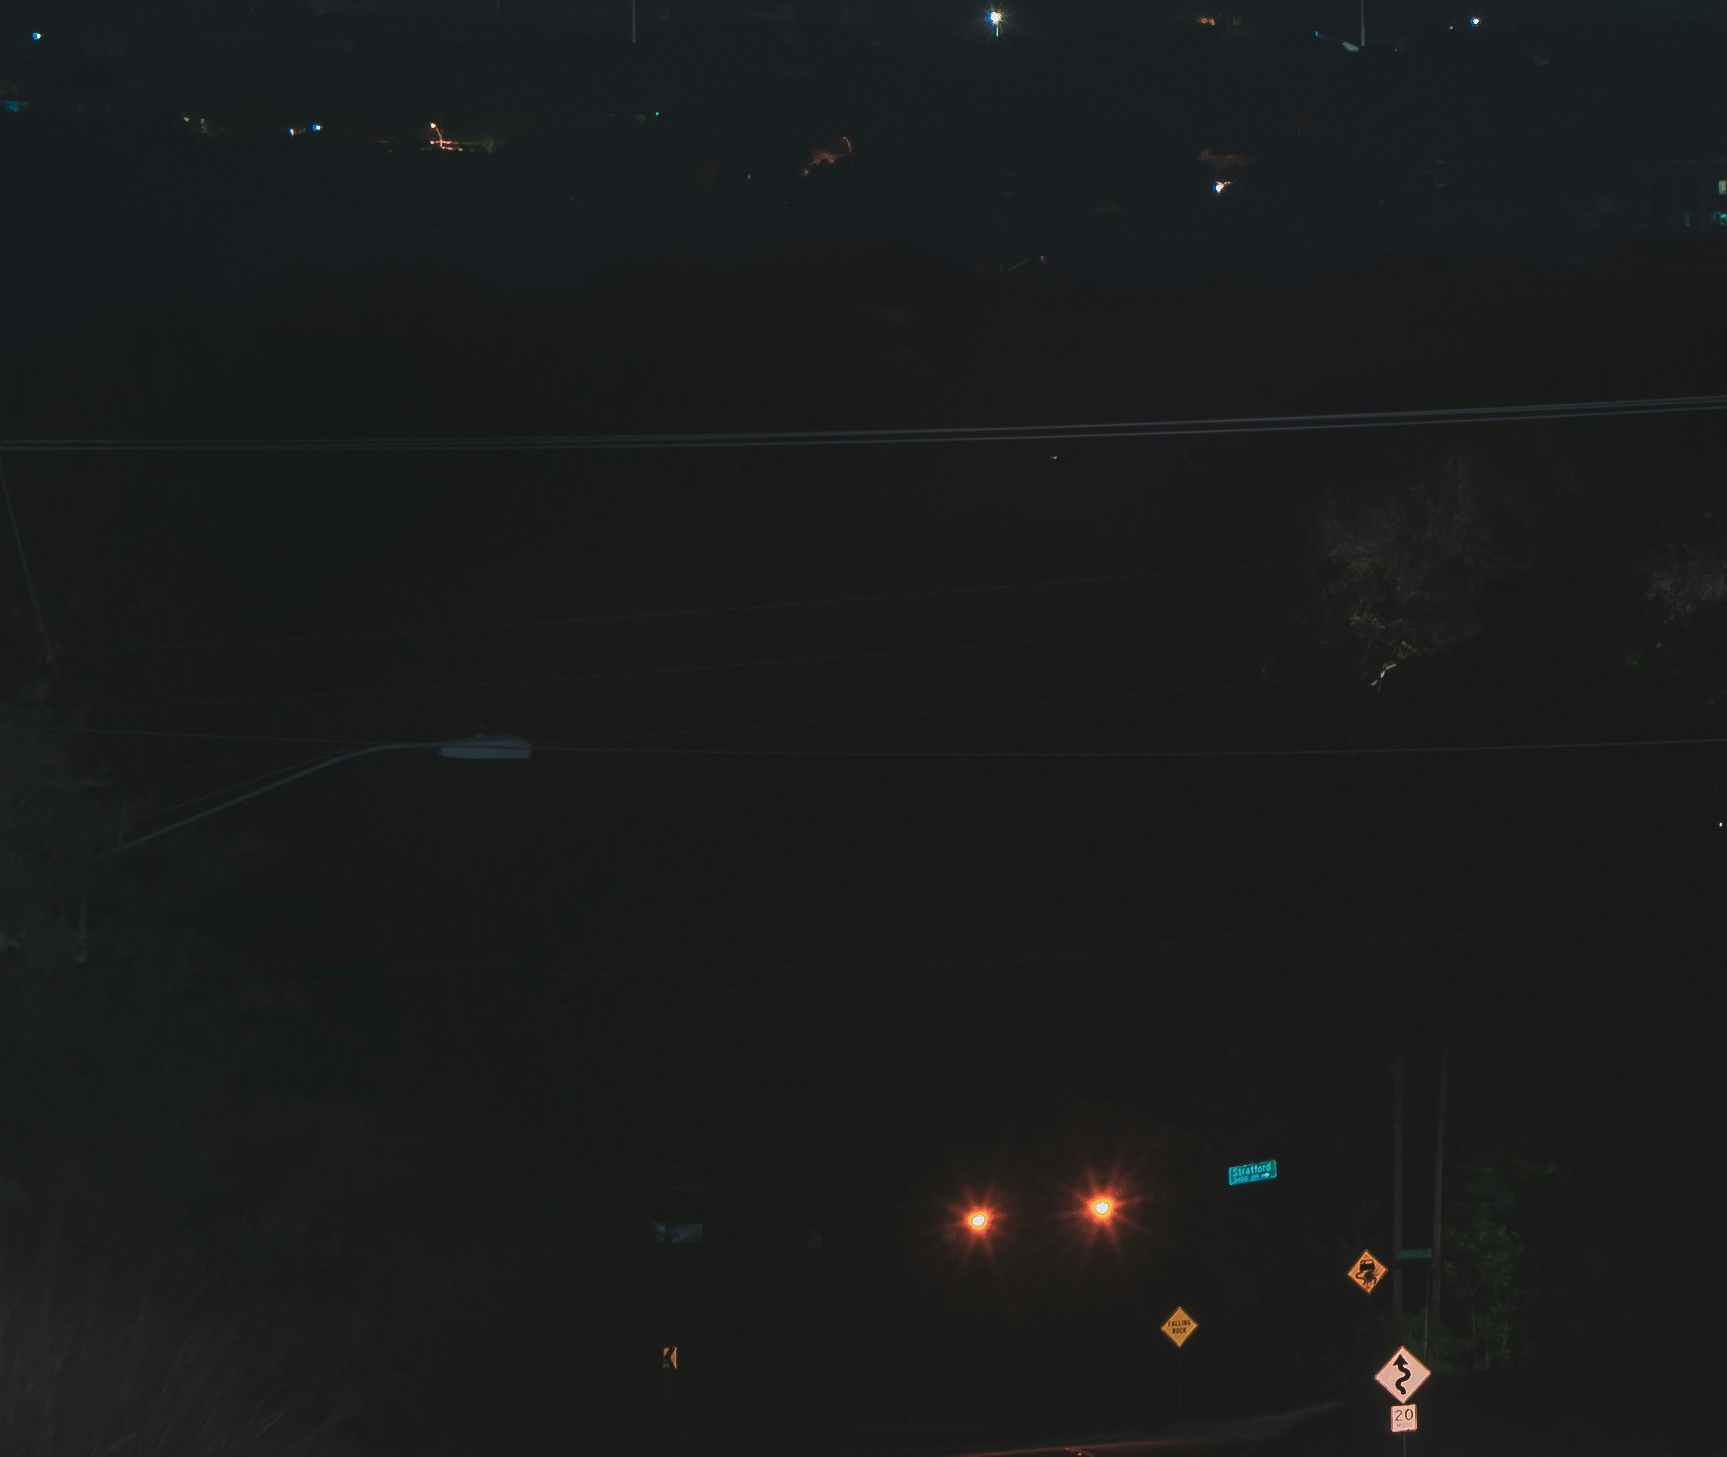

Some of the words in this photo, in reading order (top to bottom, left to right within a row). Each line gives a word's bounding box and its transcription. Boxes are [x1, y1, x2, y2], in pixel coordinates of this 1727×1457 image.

[1232, 1162, 1271, 1177] Stratford
[1168, 1319, 1191, 1327] FALLING
[1394, 1408, 1413, 1421] 20
